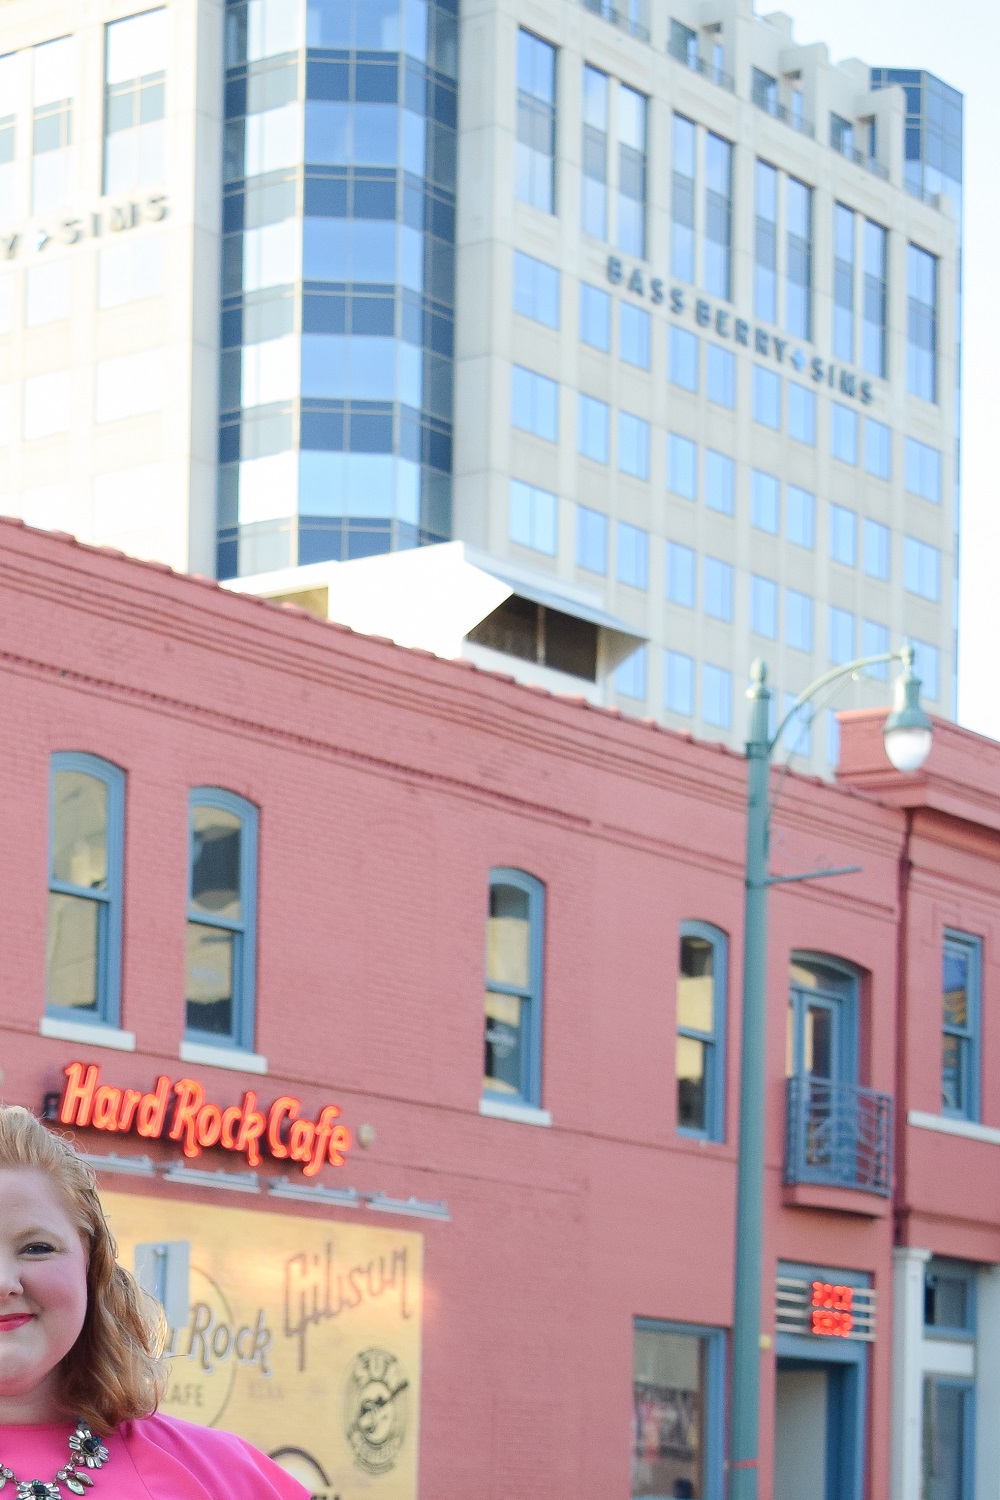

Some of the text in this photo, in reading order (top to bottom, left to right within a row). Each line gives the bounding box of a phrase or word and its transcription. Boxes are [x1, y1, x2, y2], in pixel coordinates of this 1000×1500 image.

[59, 195, 170, 245] SIMS
[606, 254, 873, 405] BASS BERRY SIMS
[60, 1061, 353, 1177] Hard Rock Cafe
[186, 1301, 274, 1377] Rock
[283, 1241, 411, 1373] Gibson
